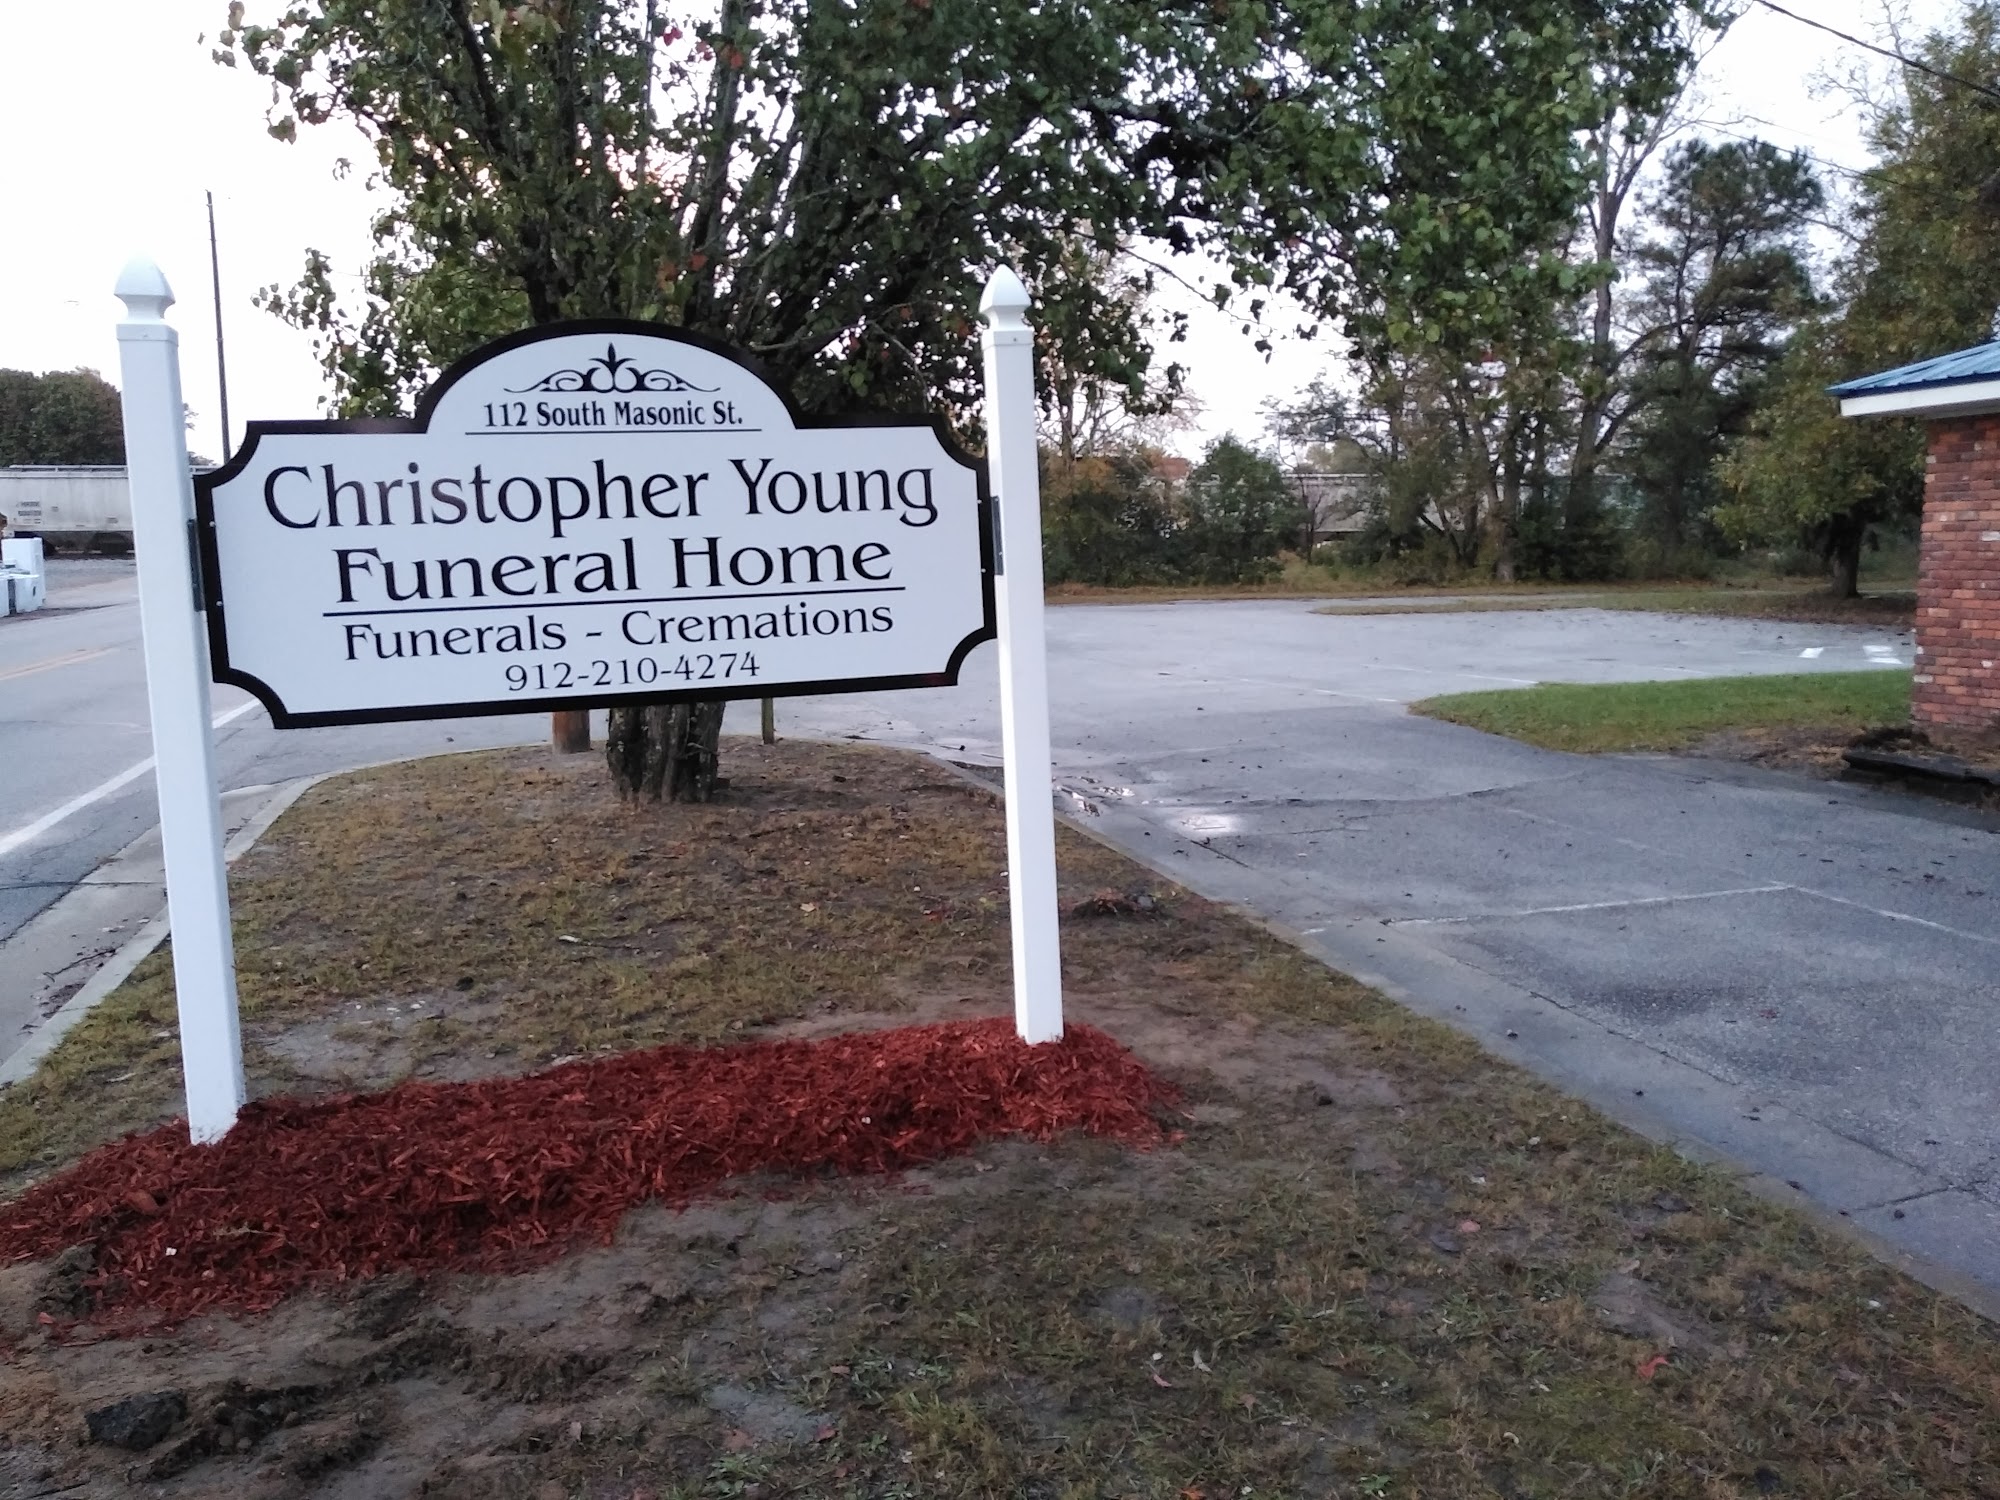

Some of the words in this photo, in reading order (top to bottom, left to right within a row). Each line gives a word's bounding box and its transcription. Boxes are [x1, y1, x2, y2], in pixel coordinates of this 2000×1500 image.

[484, 403, 528, 427] 112
[536, 401, 607, 427] South
[614, 401, 706, 426] Masonic
[713, 400, 743, 425] St.
[263, 458, 709, 539] Christopher
[728, 458, 939, 528] Young
[332, 536, 638, 603] Funeral
[669, 536, 892, 589] Home
[343, 614, 567, 661] Funerals
[621, 601, 894, 646] Cremations
[505, 651, 760, 692] 912-210-4274
